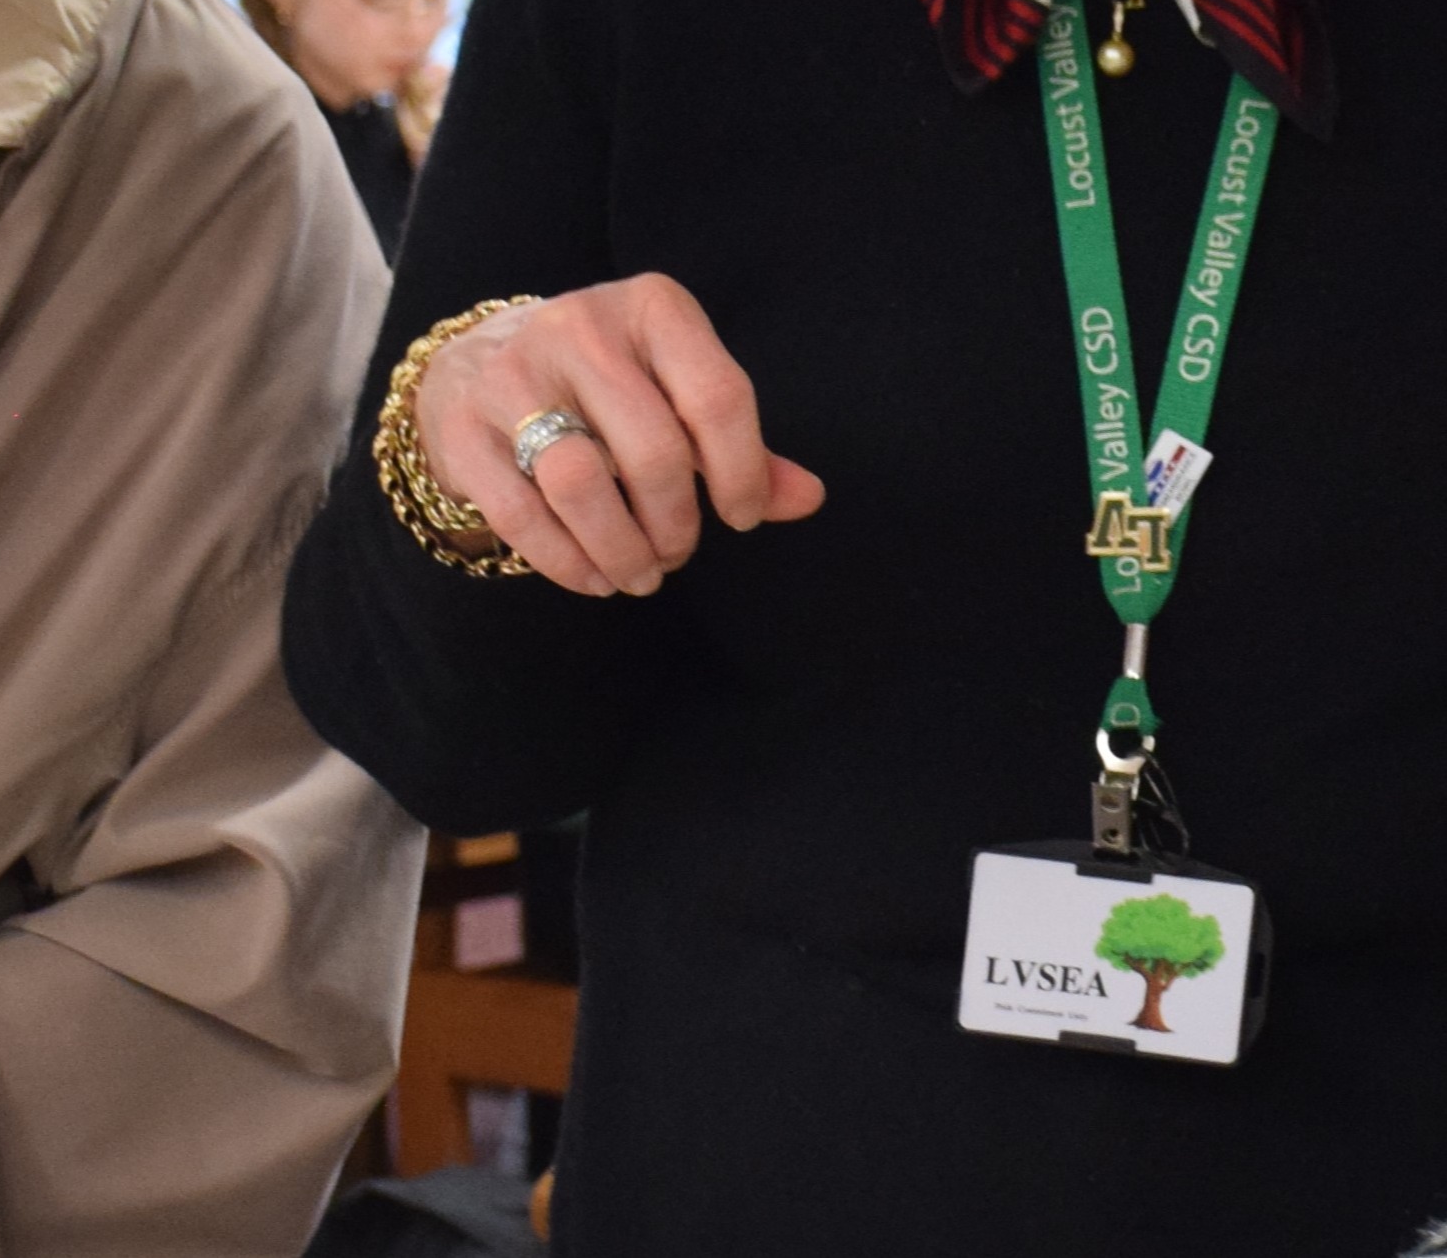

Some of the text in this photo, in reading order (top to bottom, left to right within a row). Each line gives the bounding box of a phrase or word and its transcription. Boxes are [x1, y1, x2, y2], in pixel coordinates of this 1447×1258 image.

[1043, 4, 1096, 209] Locust Valley
[1178, 98, 1271, 383] Locust Valley CSD
[1081, 306, 1131, 482] Valley CSD
[985, 955, 1109, 998] LVSEA
